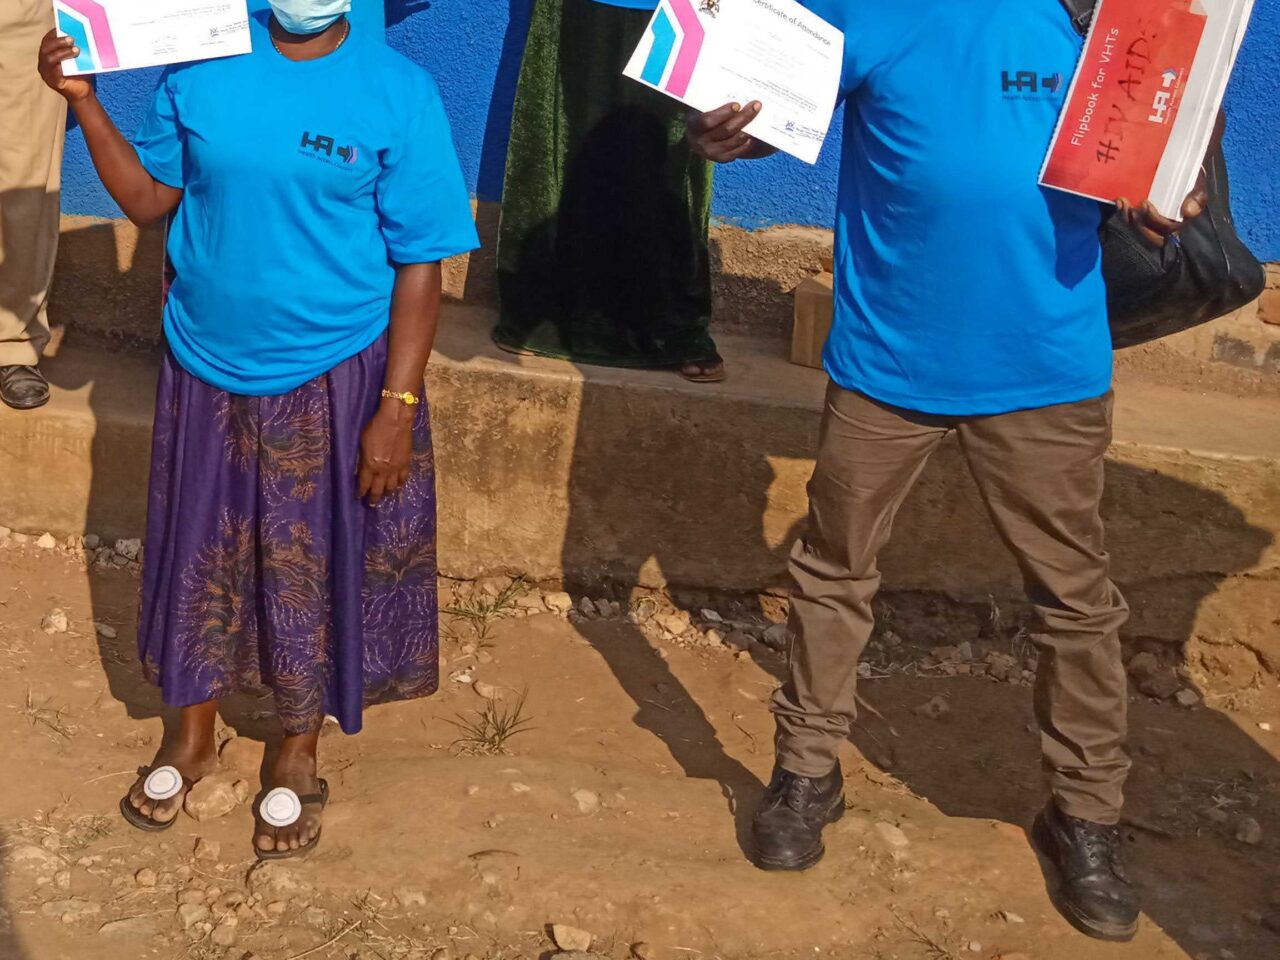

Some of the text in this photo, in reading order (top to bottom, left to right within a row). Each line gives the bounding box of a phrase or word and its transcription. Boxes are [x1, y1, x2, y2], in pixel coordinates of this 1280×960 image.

[1071, 27, 1119, 146] Flipbook for VHTs
[1095, 104, 1128, 165] HIV
